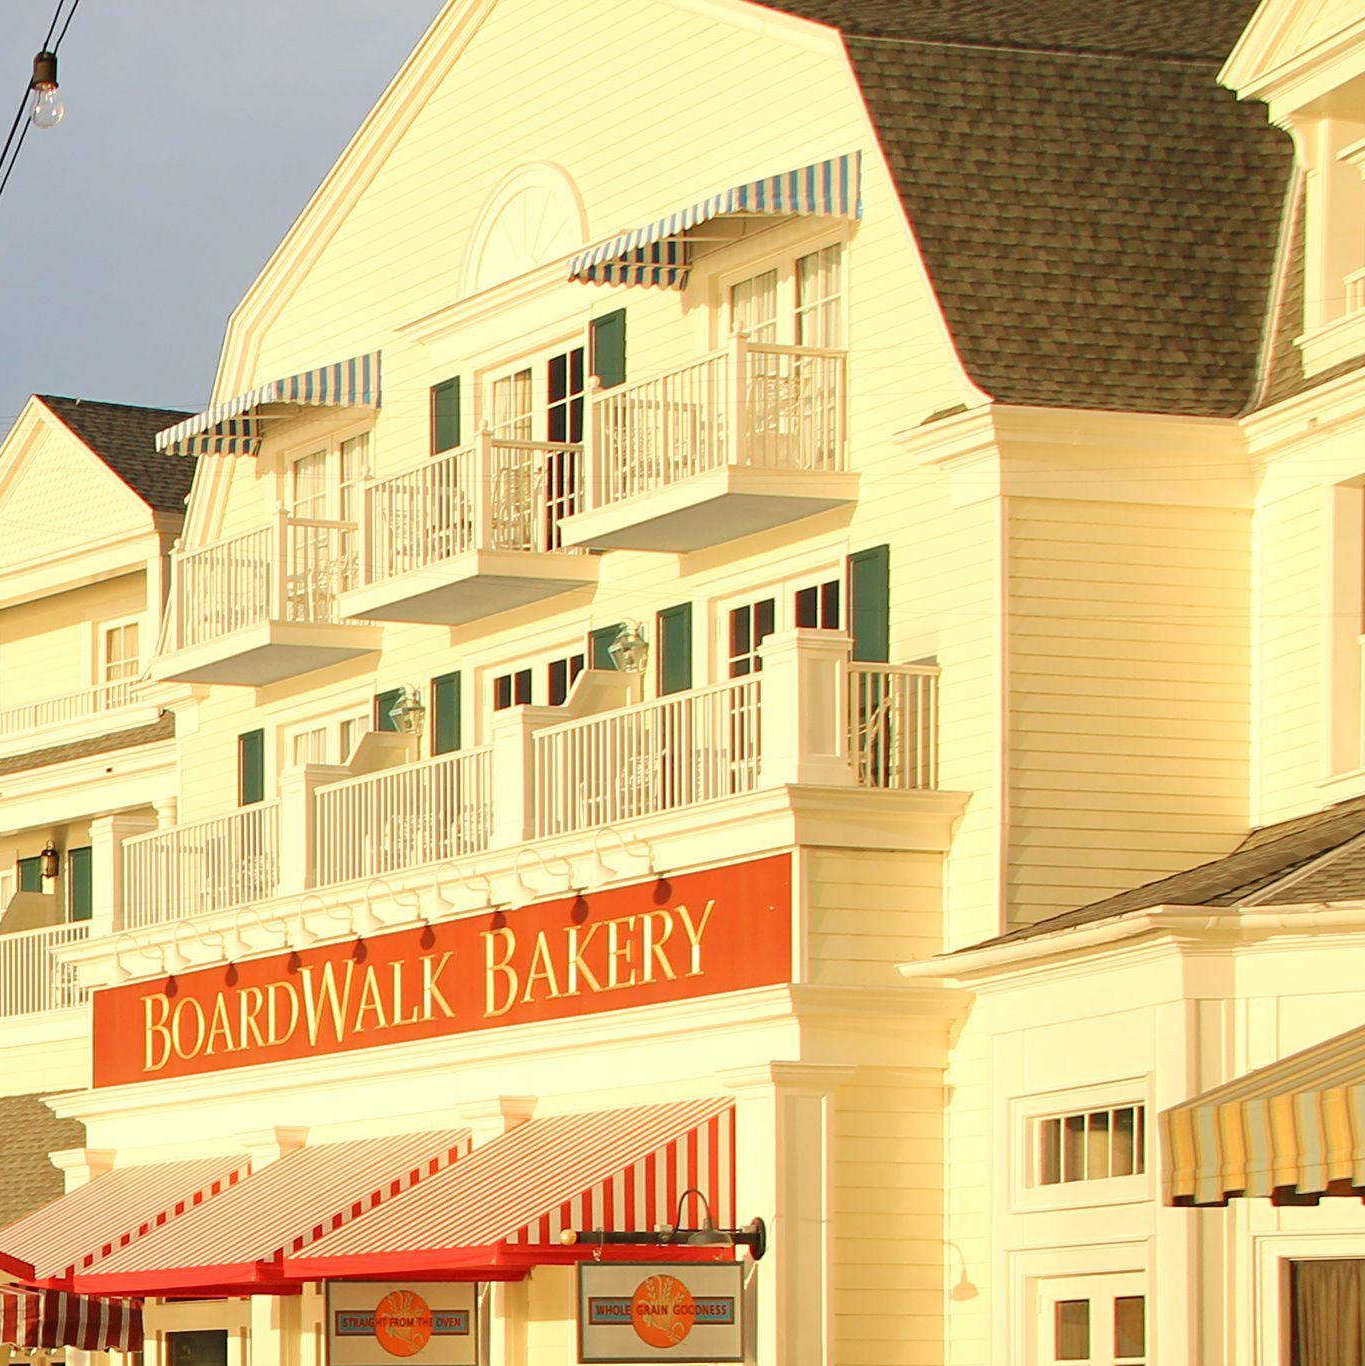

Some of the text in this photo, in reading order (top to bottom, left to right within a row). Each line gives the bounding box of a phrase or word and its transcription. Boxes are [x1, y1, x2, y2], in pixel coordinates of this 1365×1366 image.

[479, 899, 715, 1019] BAKERY
[596, 1304, 728, 1316] WHOLE GRAIN GOODNESS
[342, 1316, 462, 1328] STRAIGHT FROM THE OVEN
